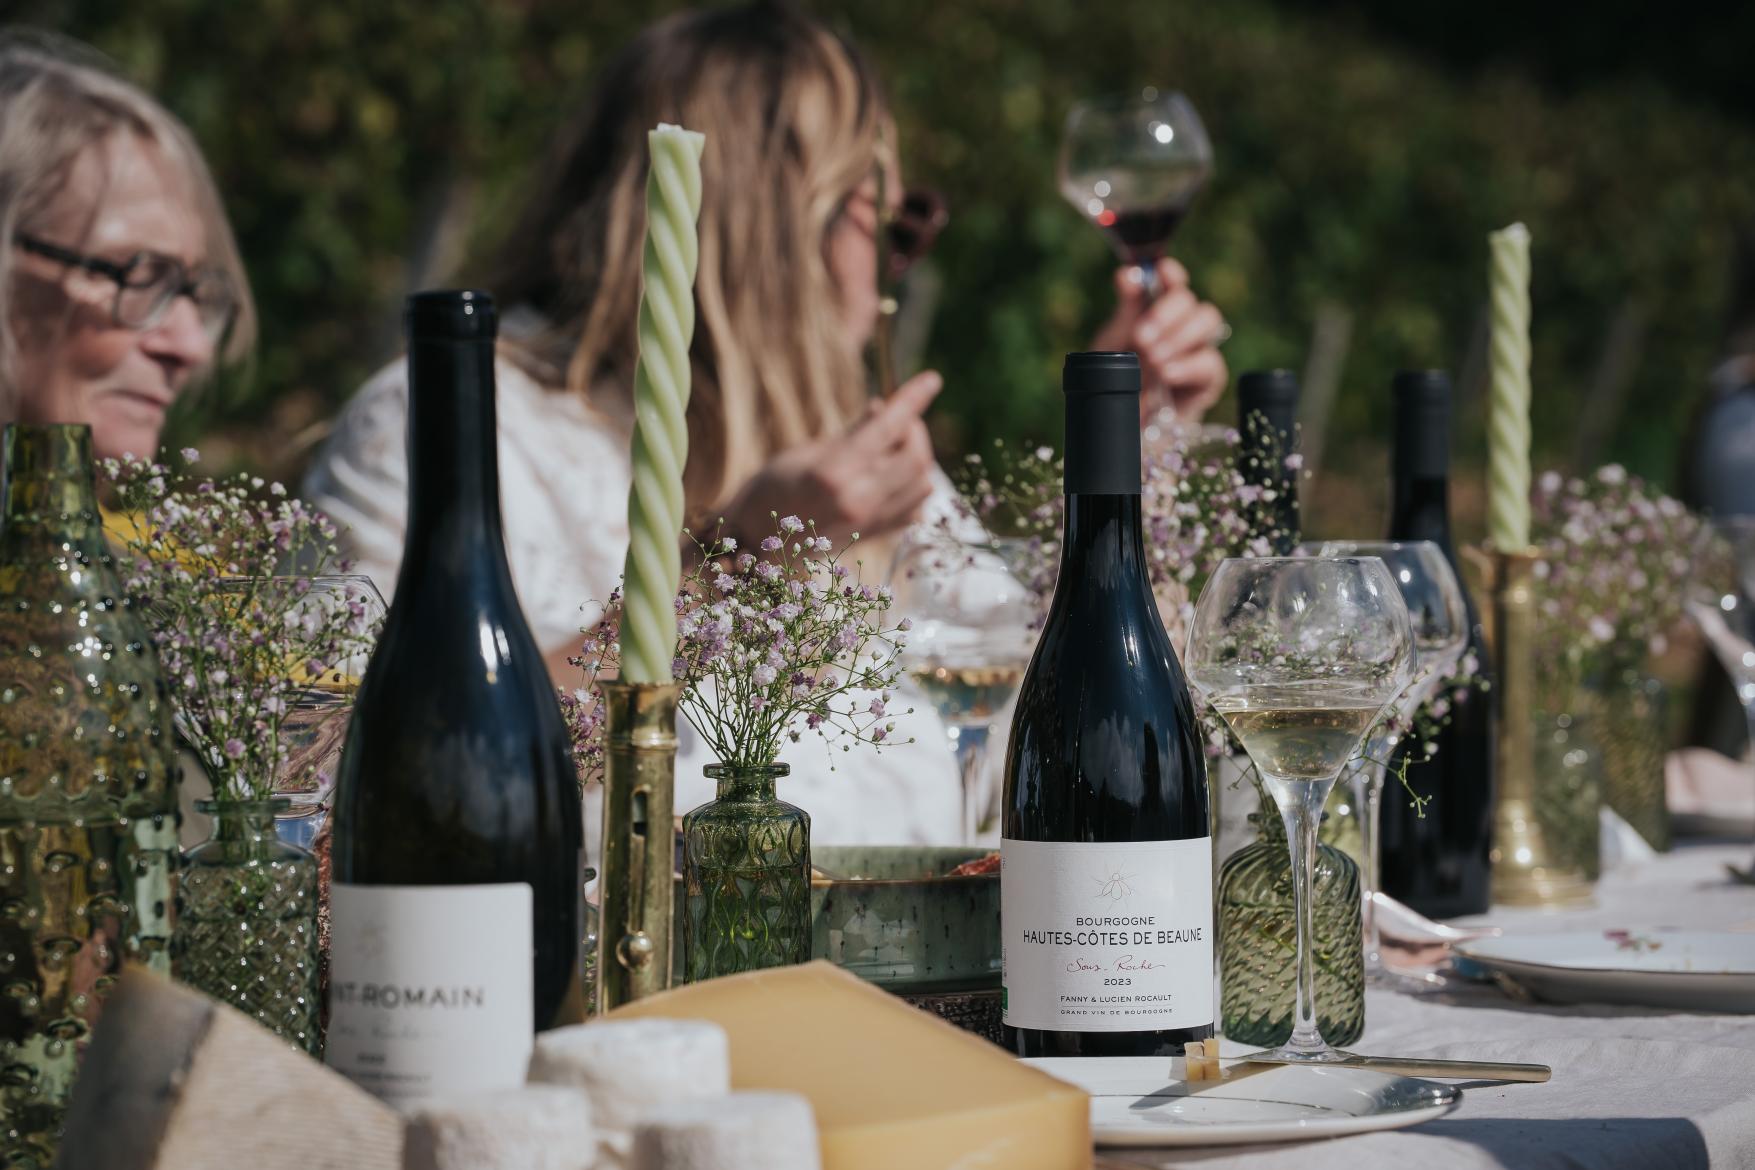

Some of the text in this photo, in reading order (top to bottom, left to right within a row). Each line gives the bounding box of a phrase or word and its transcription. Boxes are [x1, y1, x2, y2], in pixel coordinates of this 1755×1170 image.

[1076, 916, 1156, 926] BOURGOGNE
[1023, 927, 1202, 946] HAUTES-CÔTES DE BEAUNE
[1103, 978, 1132, 987] 2023
[1060, 995, 1088, 1003] FANNY
[1134, 994, 1172, 1002] ROCAULT
